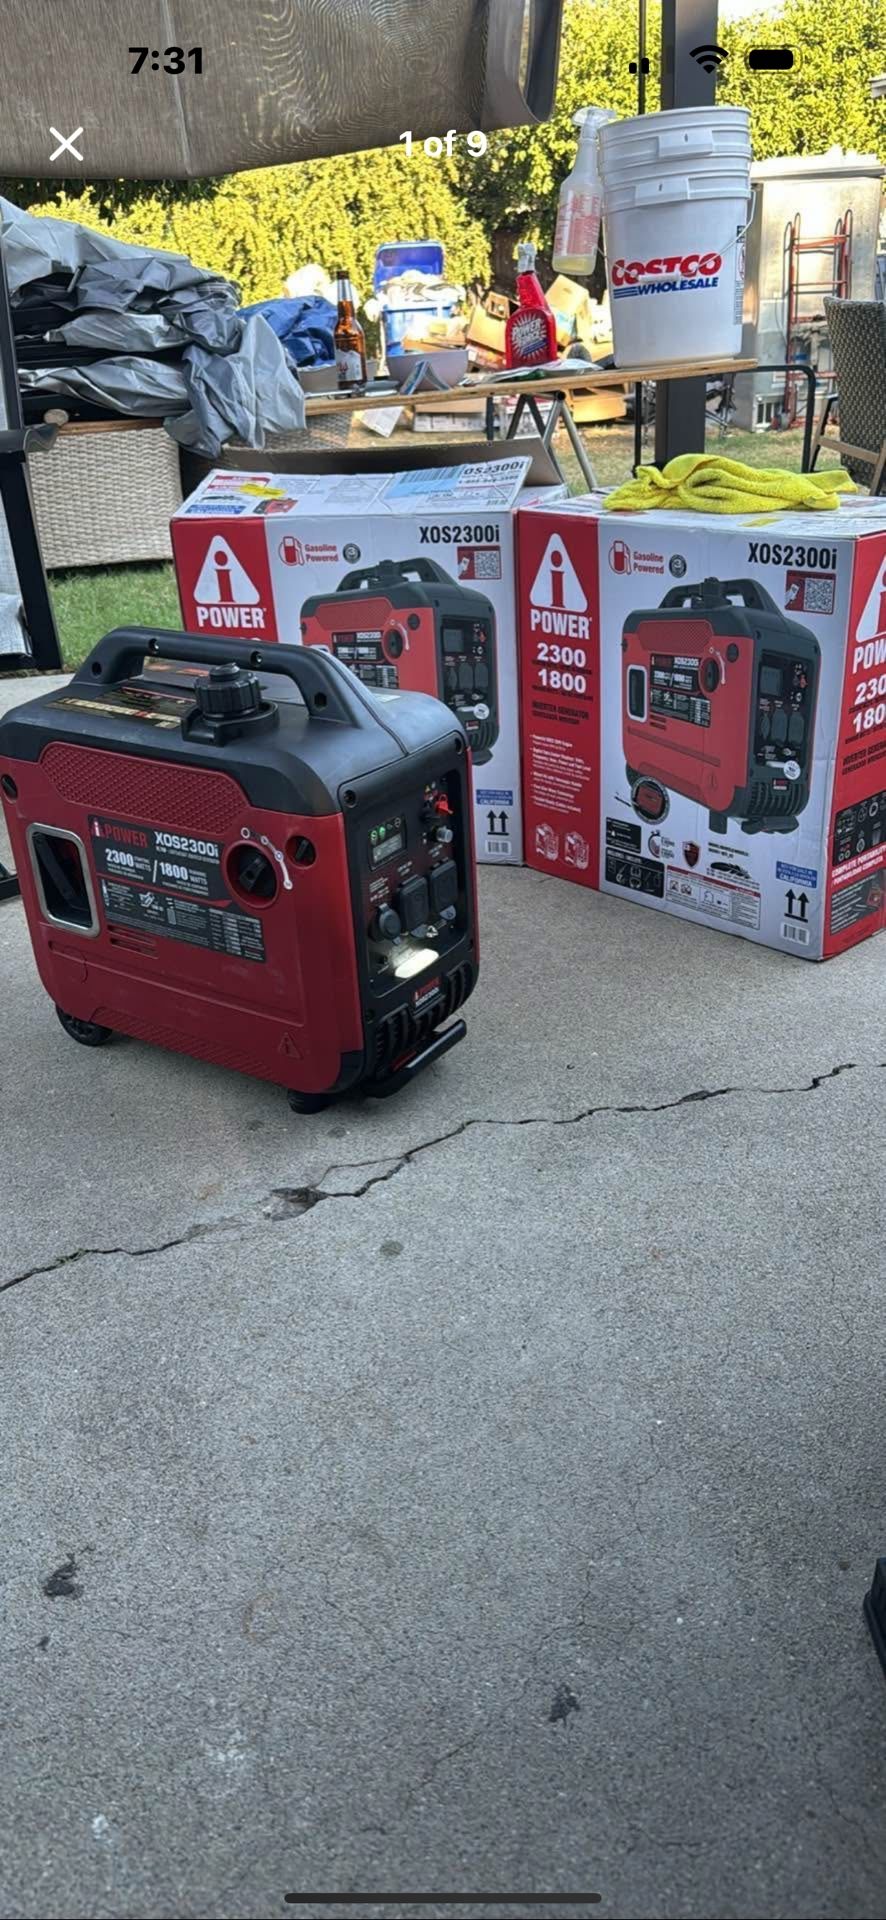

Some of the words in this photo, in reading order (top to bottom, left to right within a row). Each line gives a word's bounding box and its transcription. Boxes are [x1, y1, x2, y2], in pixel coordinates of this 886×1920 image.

[611, 252, 722, 286] COSTCO
[637, 277, 719, 295] WHOLESALE
[418, 525, 499, 544] XOS2300i
[304, 543, 337, 553] Gasoline
[305, 553, 338, 563] Powered
[633, 551, 664, 563] Gasoline
[748, 543, 837, 570] XOS2300i
[633, 562, 665, 574] Powered
[196, 606, 265, 629] POWER
[530, 608, 591, 640] POWER
[537, 642, 586, 668] 2300
[538, 668, 586, 693] 1800
[104, 823, 148, 848] POWER
[154, 831, 219, 857] XOS2300i
[105, 848, 134, 867] 2300
[159, 862, 188, 880] 1800
